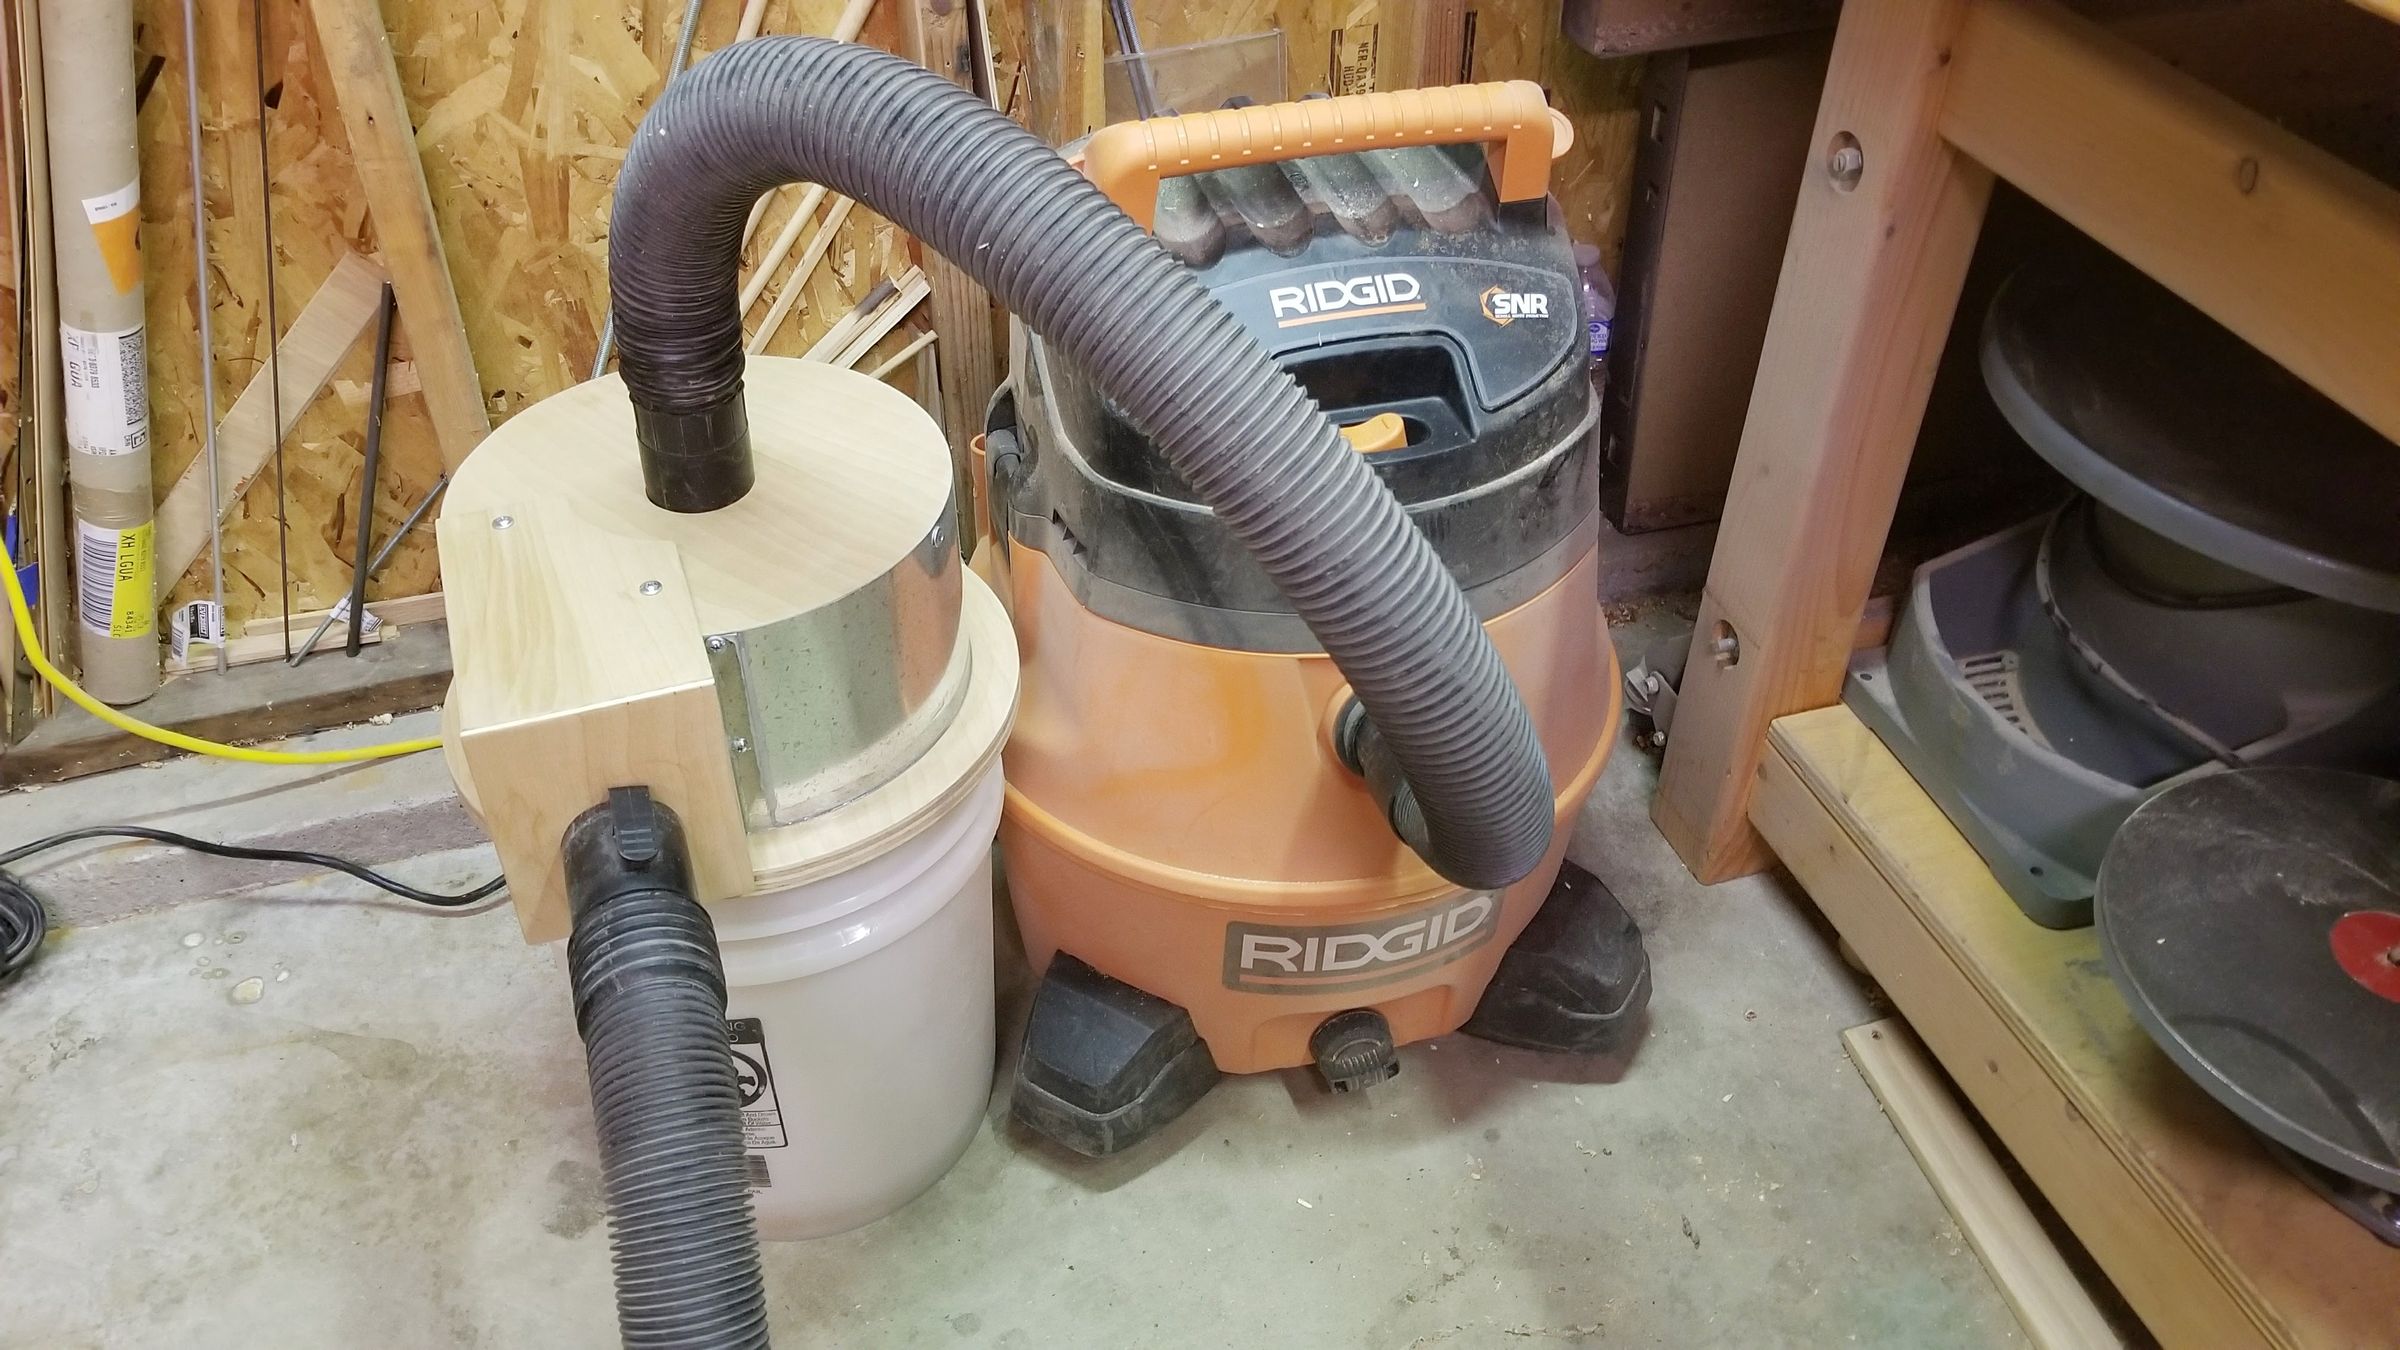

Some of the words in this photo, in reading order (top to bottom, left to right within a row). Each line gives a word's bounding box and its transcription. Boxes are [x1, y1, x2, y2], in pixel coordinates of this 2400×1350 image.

[1343, 66, 1355, 96] HUD-
[1269, 273, 1420, 318] RIDGID
[1491, 293, 1549, 314] SNR
[121, 533, 136, 548] XH
[118, 554, 135, 582] LGUA
[1240, 896, 1492, 972] RIDGID
